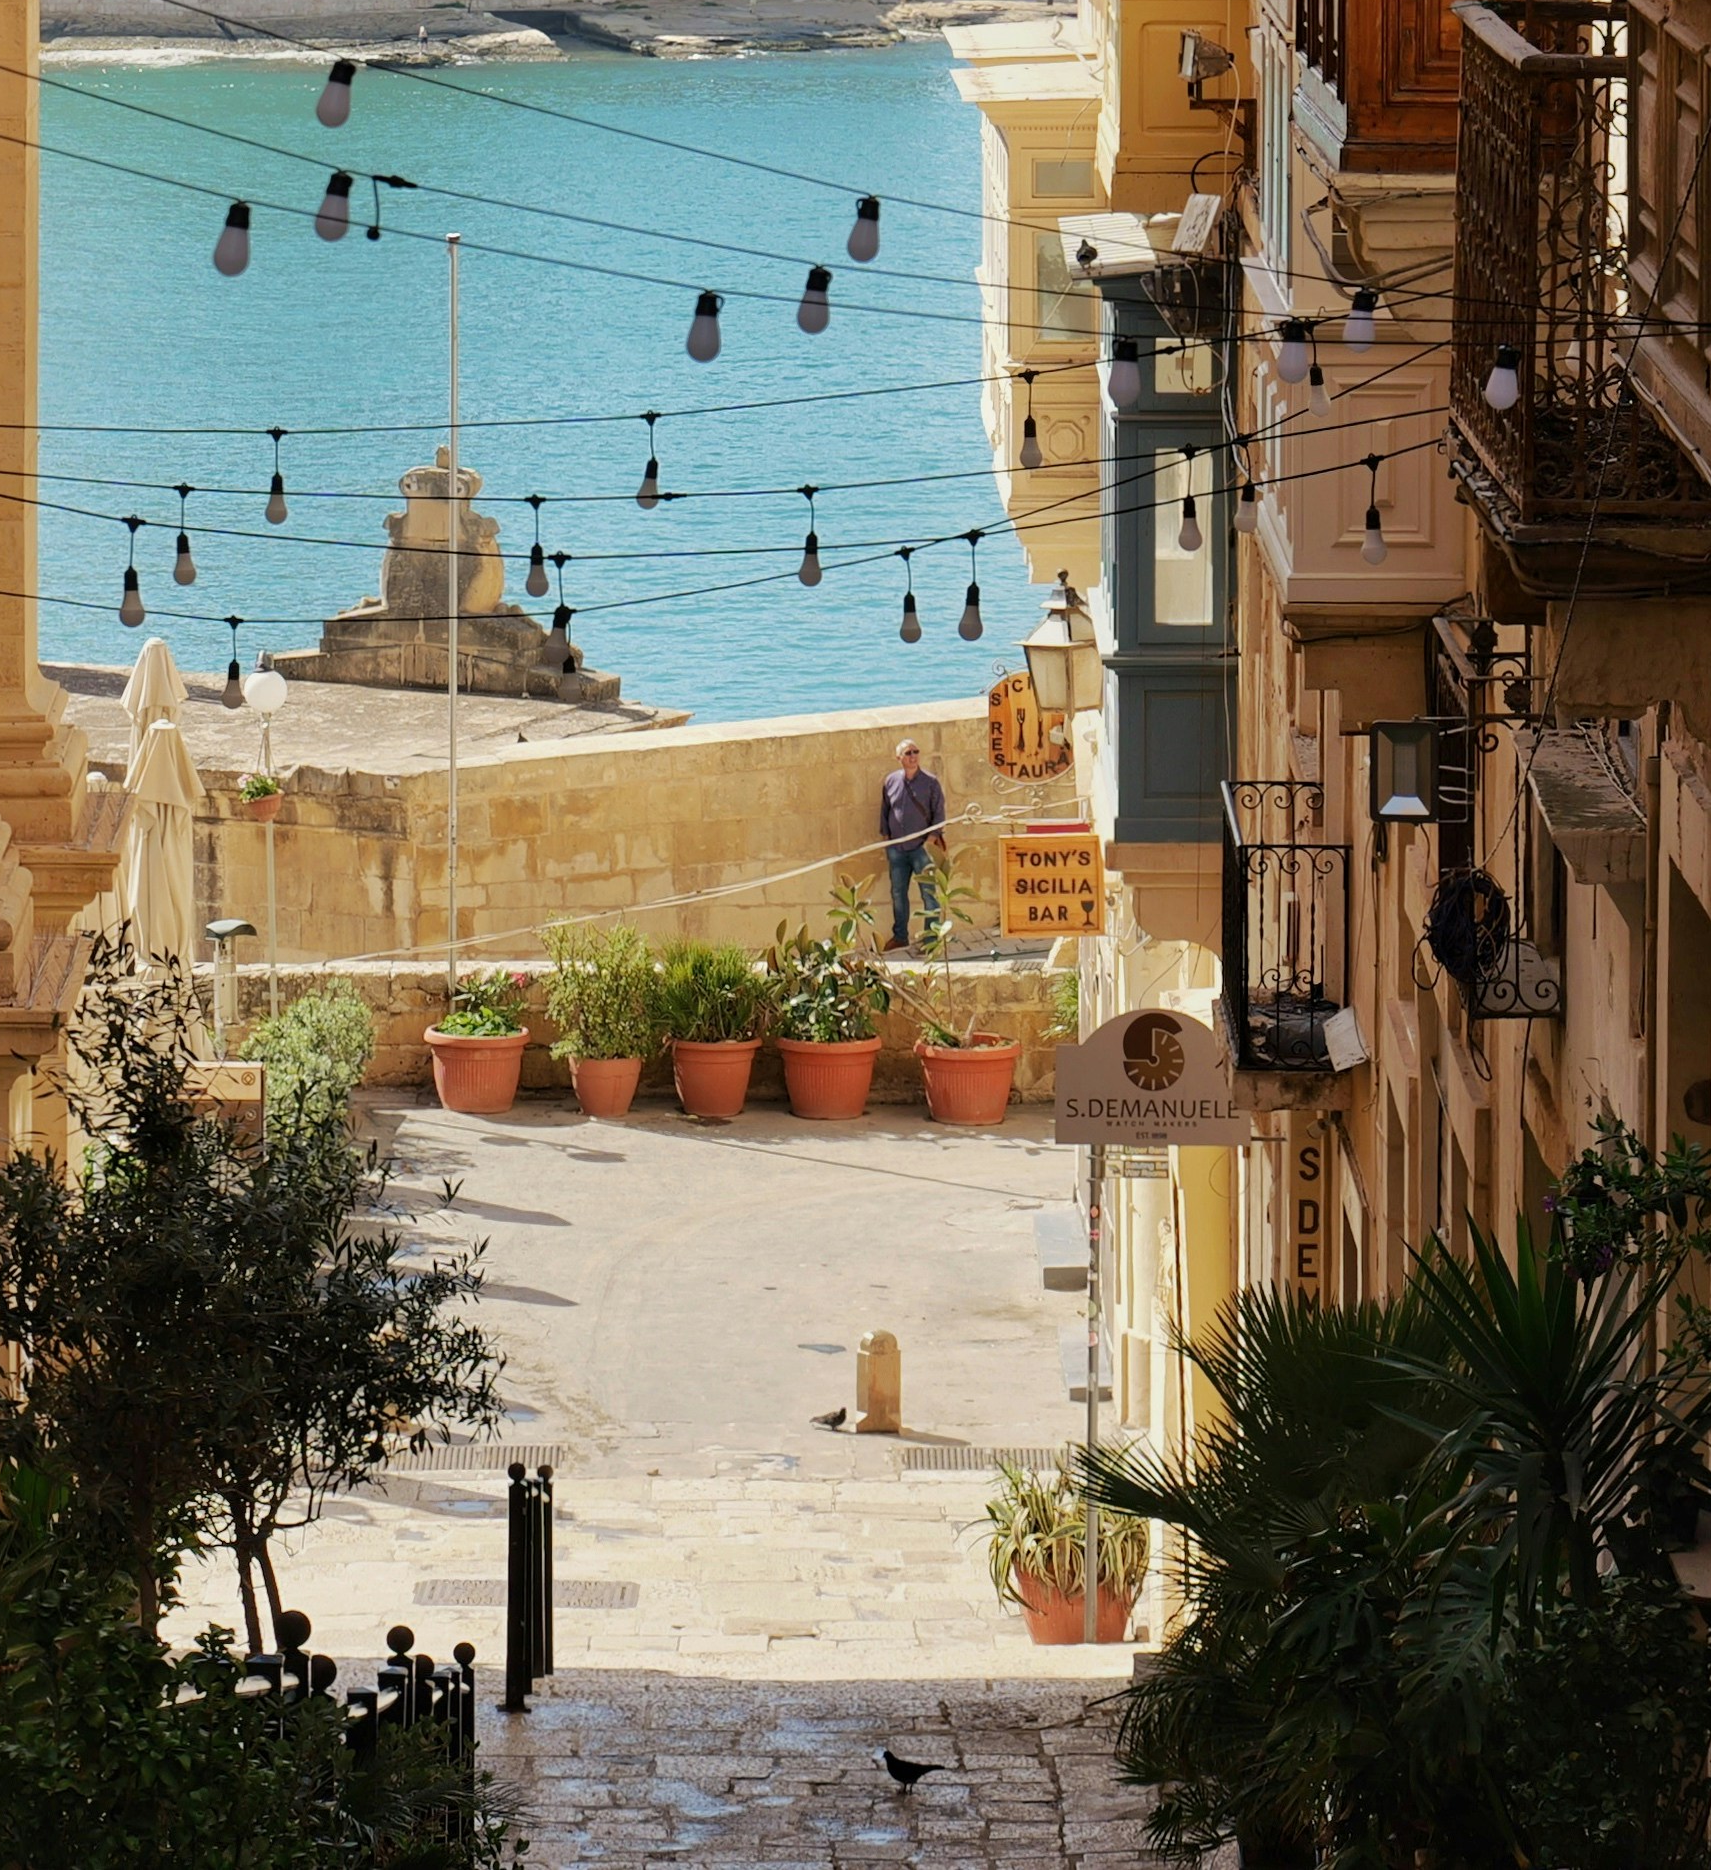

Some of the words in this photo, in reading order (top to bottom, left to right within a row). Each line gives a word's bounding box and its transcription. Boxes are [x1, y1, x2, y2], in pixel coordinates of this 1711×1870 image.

[1015, 850, 1091, 868] TONY'S
[1015, 878, 1093, 895] SICILIA
[1028, 906, 1068, 921] BAR
[1106, 1120, 1145, 1128] WATCH
[1154, 1120, 1198, 1128] MAKERS
